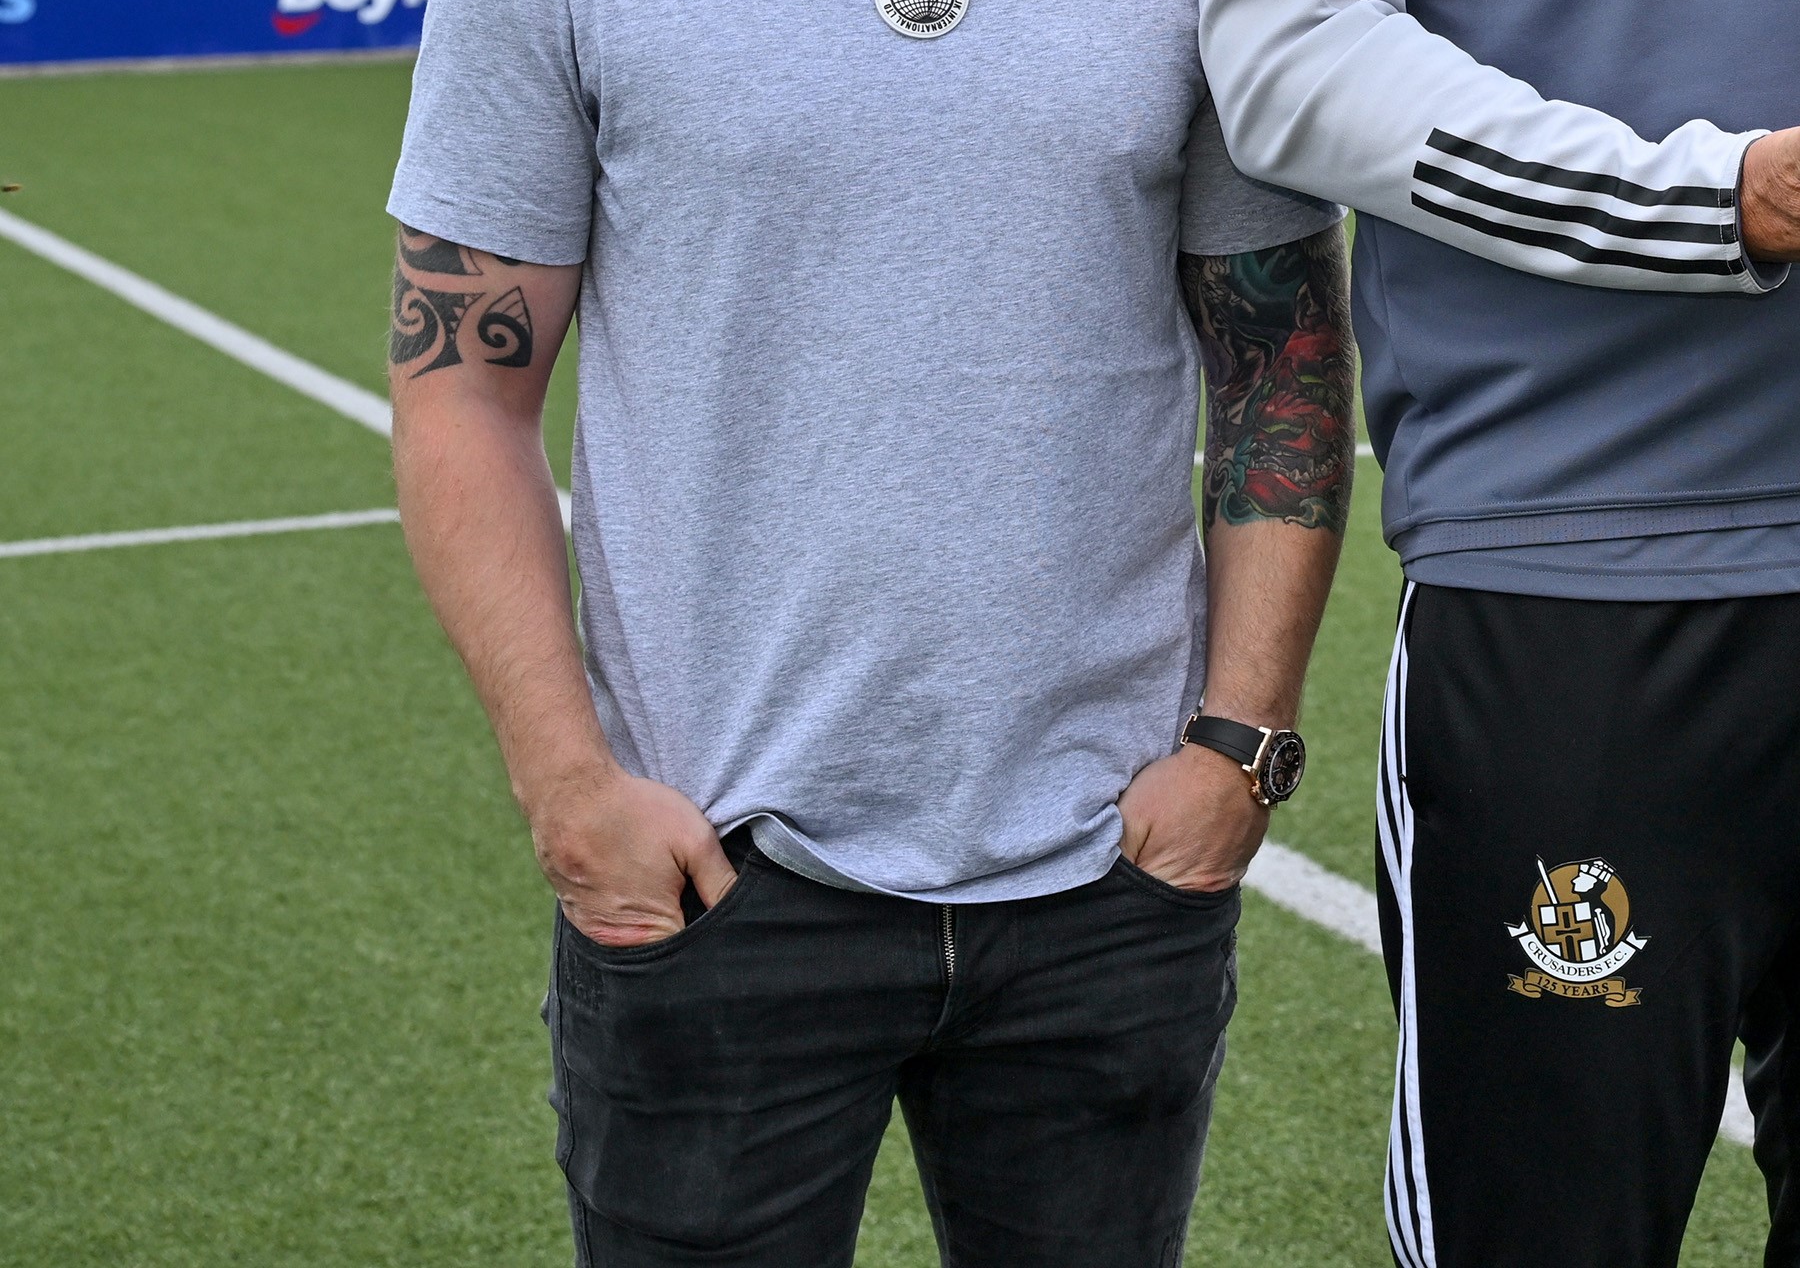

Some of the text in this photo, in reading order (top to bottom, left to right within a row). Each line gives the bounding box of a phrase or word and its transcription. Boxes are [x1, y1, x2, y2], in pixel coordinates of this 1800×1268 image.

[884, 3, 898, 18] LTD
[896, 11, 958, 33] INTERNATIONAL
[1527, 940, 1628, 977] CRUSADERS F.C.
[1537, 976, 1609, 997] 125 YEARS
